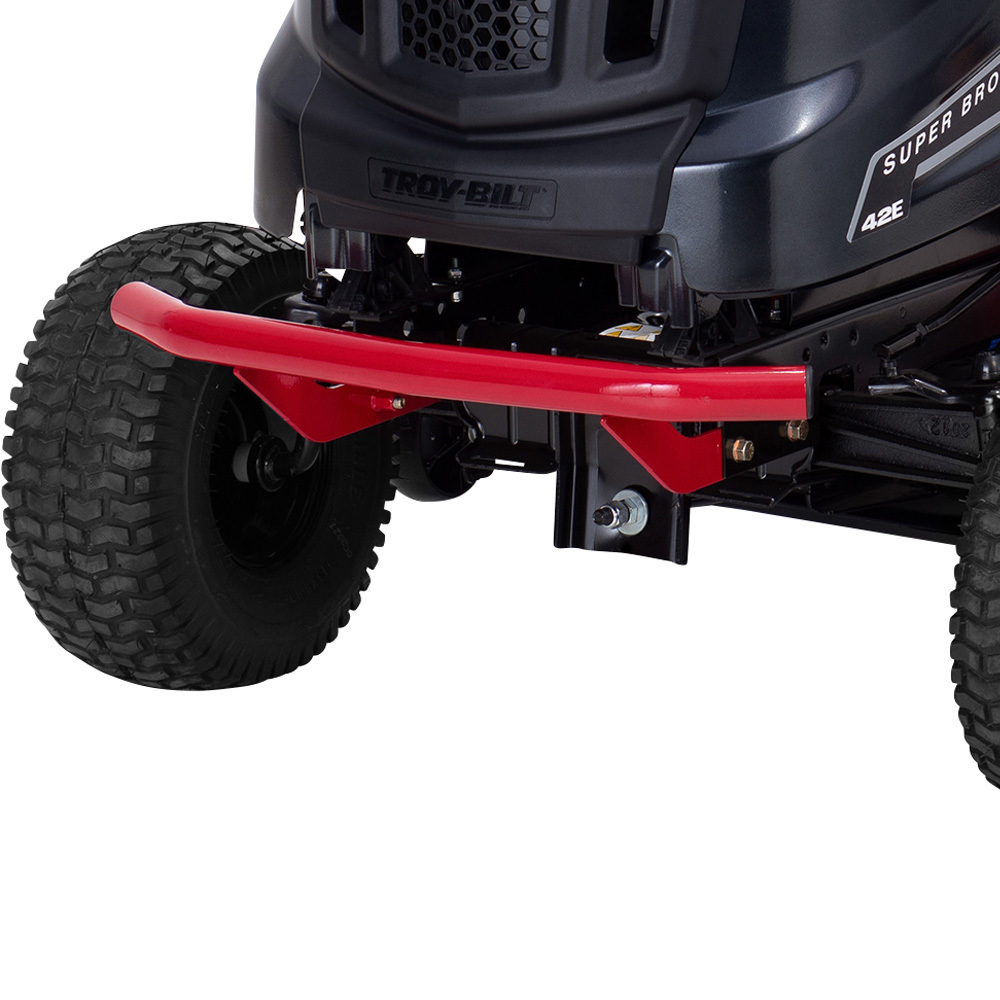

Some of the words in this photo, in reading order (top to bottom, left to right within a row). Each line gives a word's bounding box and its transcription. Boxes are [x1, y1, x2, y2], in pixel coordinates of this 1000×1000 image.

[883, 110, 953, 176] SUPER
[382, 167, 541, 211] TROY-BILT
[861, 198, 904, 232] 42E
